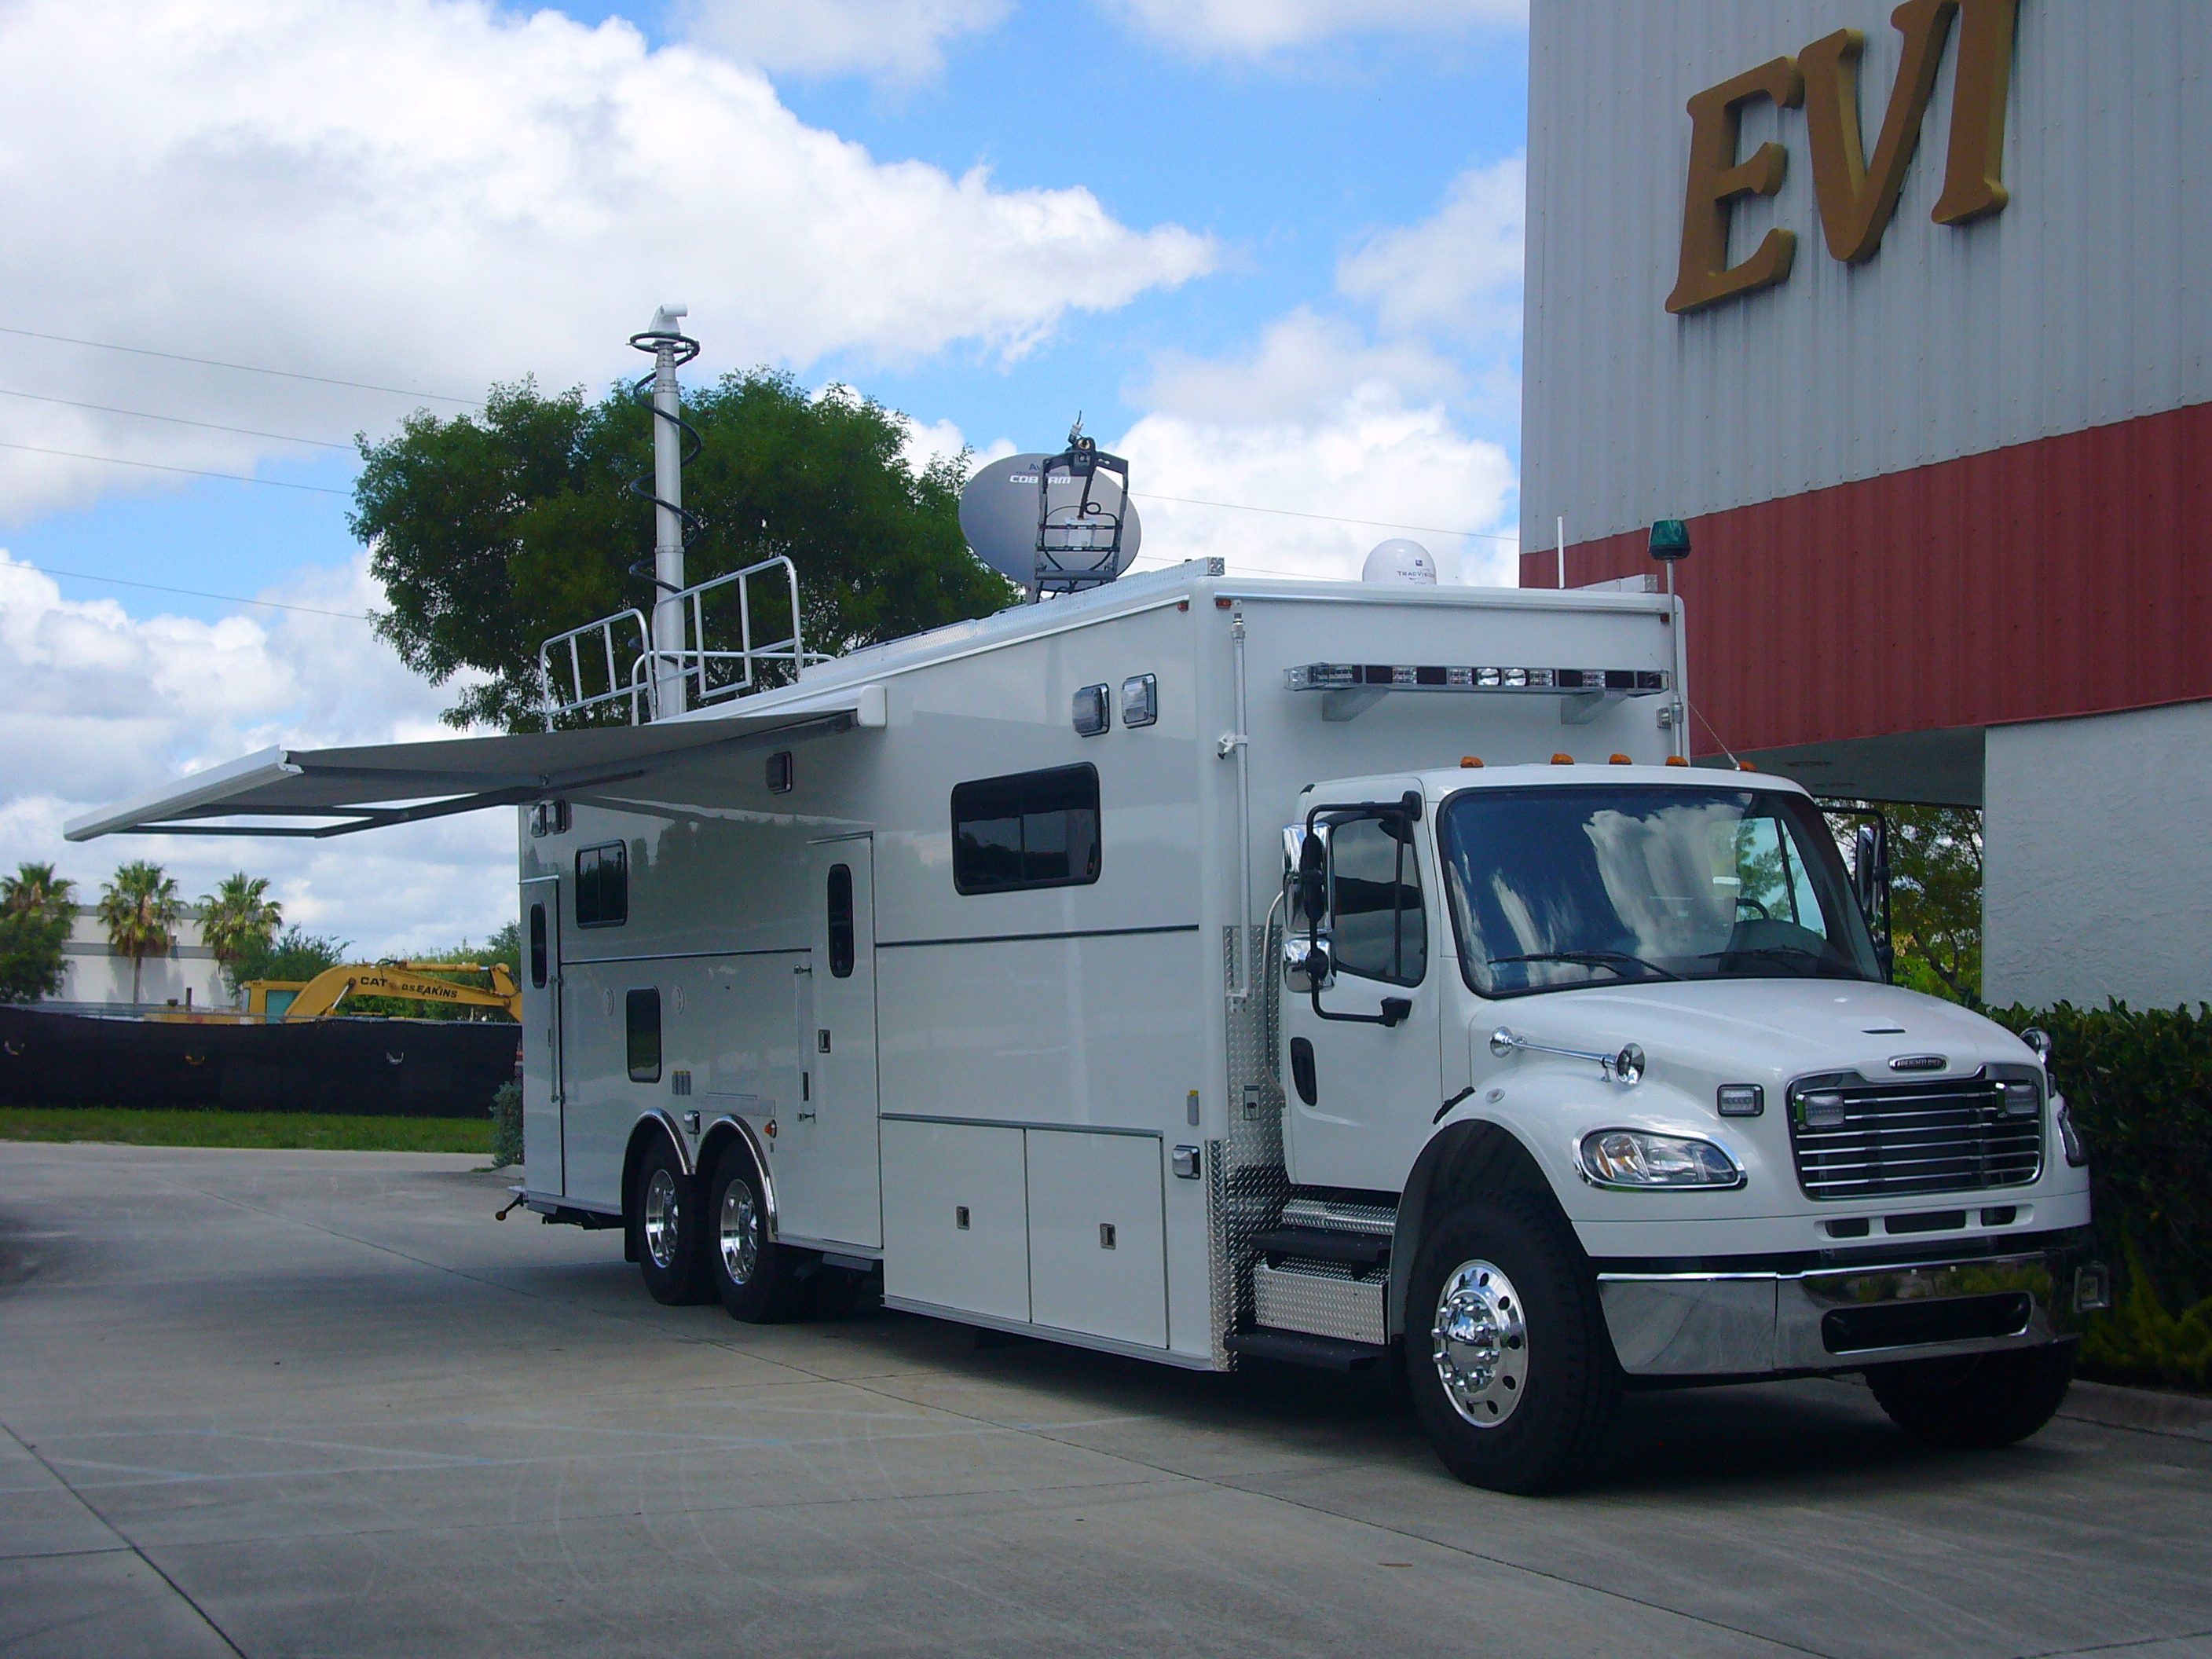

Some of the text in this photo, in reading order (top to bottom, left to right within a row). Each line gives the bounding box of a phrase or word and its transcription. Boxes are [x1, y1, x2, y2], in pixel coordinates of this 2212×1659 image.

[1664, 0, 2020, 314] EVI
[1009, 475, 1071, 484] COBAM
[361, 976, 387, 987] CAT
